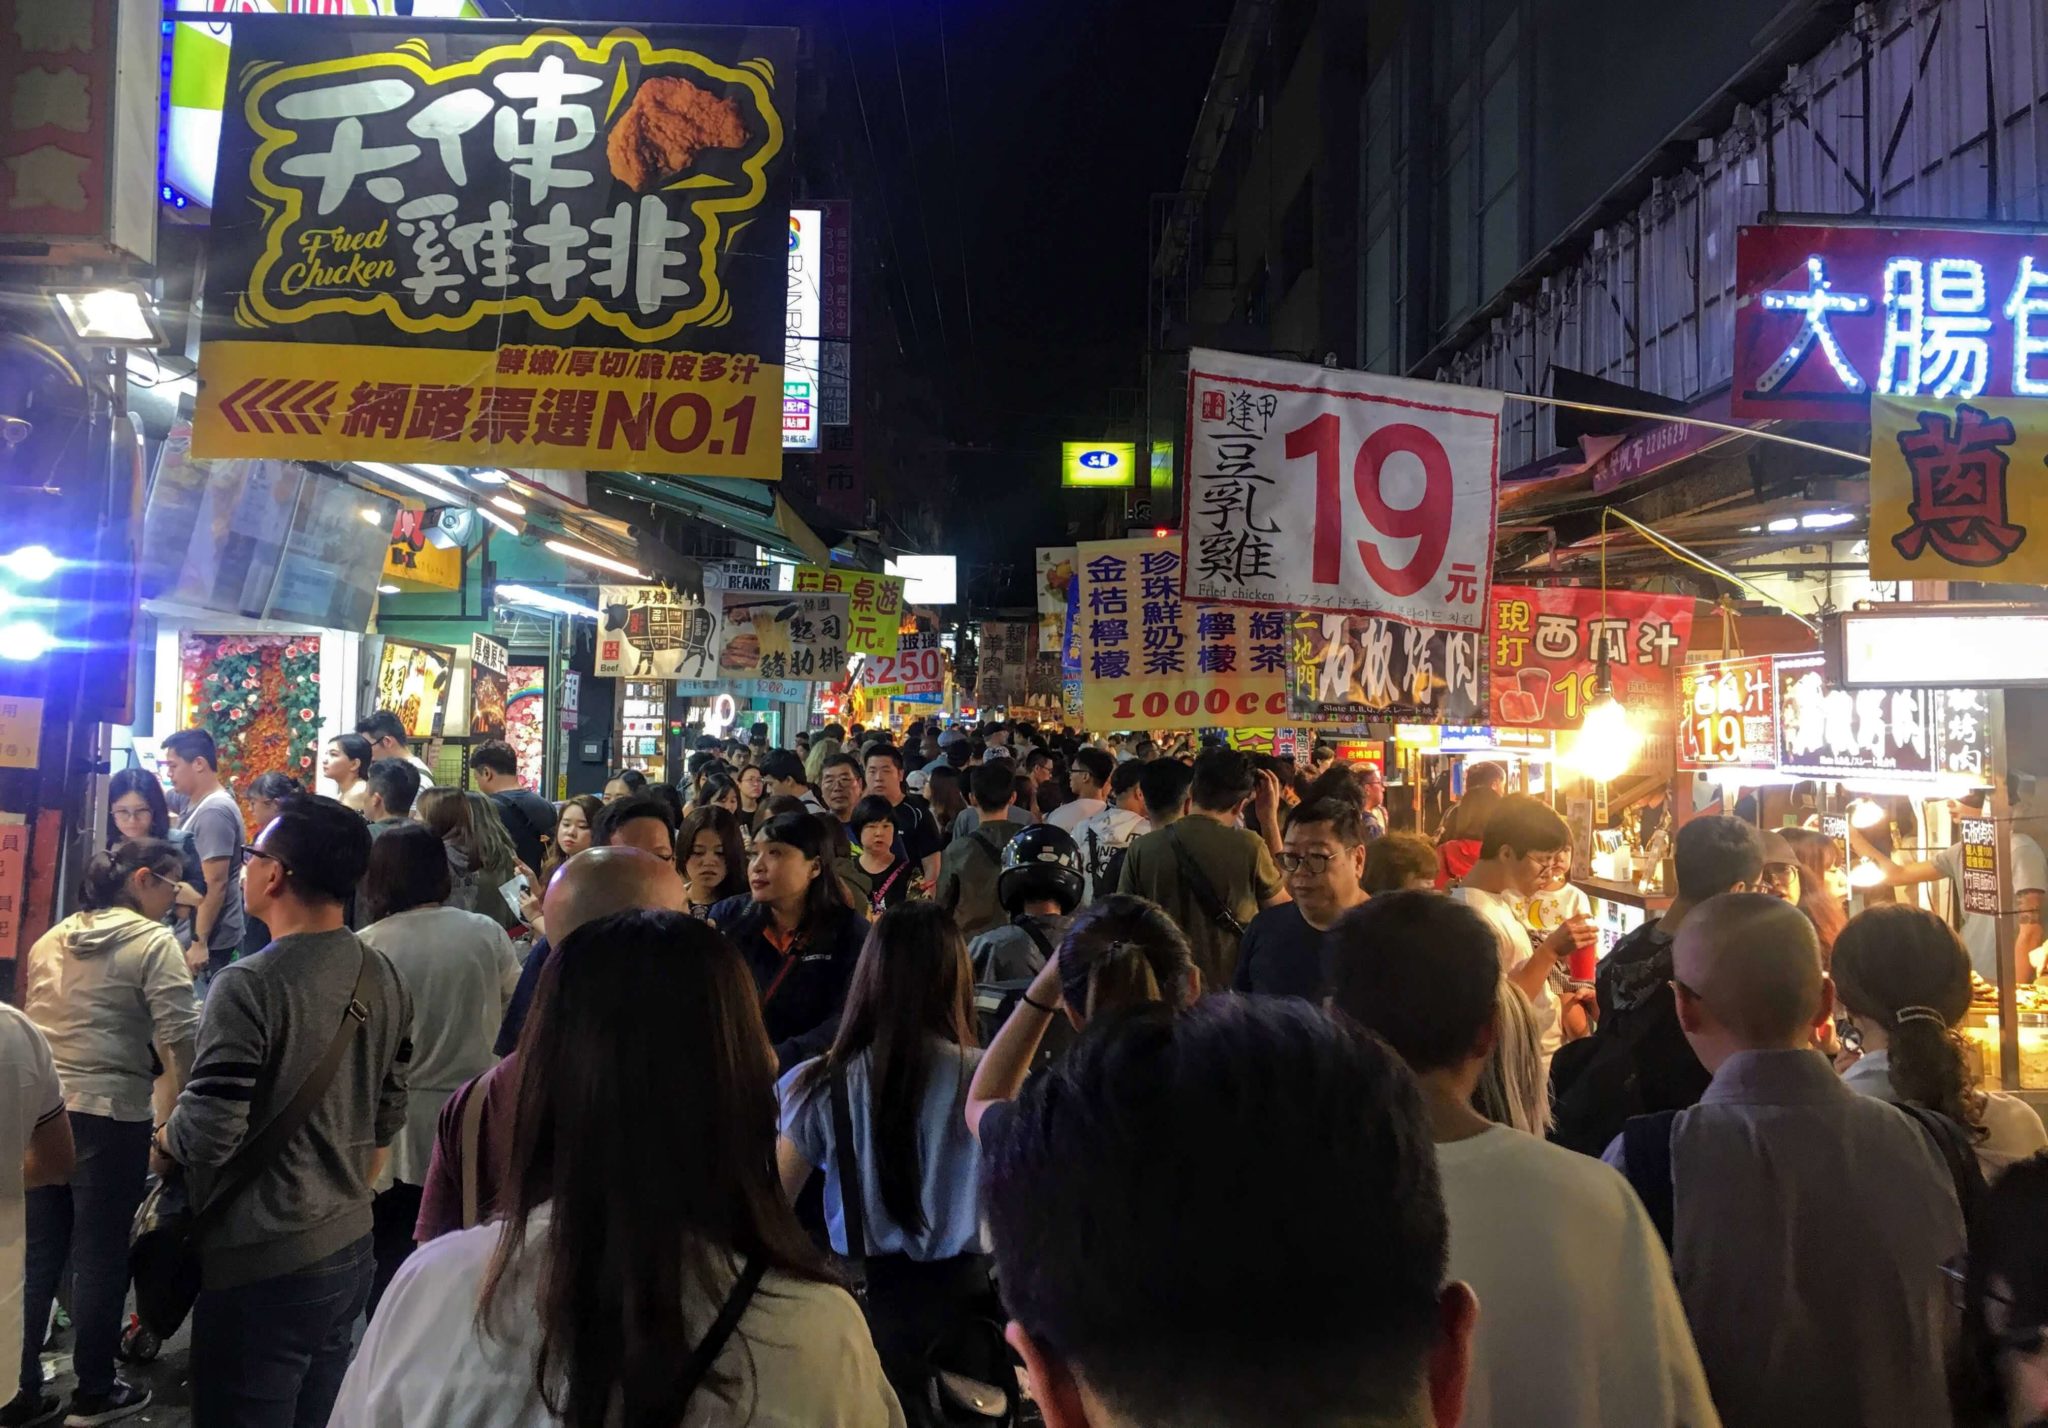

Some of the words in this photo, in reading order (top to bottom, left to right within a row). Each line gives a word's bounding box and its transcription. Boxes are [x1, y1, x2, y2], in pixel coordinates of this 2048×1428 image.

[275, 55, 604, 214] 天使
[298, 219, 388, 264] Fried
[397, 195, 691, 313] 雞排
[281, 253, 396, 295] Chicken
[785, 254, 803, 372] RAINBOW
[495, 347, 760, 385] 鮮嫩/厚切/脆皮多汁
[341, 381, 758, 456] 網路票選NO.1
[1196, 433, 1282, 586] 豆乳雞
[1285, 412, 1454, 597] 19
[1444, 562, 1478, 604] 元
[637, 590, 704, 606] 厚燒原
[853, 576, 900, 615] 桌遊
[1086, 553, 1130, 679] 金桔檸檬
[1139, 550, 1185, 675] 珍珠鮮奶茶
[1232, 586, 1274, 601] chicken
[1196, 604, 1237, 674] 檸檬
[1497, 601, 1530, 667] 現打
[1536, 614, 1679, 666] 西瓜汁
[600, 664, 619, 672] Beef
[761, 646, 844, 679] 豬肋排
[865, 650, 939, 685] $250
[1112, 688, 1286, 718] 1000cc
[1696, 715, 1742, 762] 19
